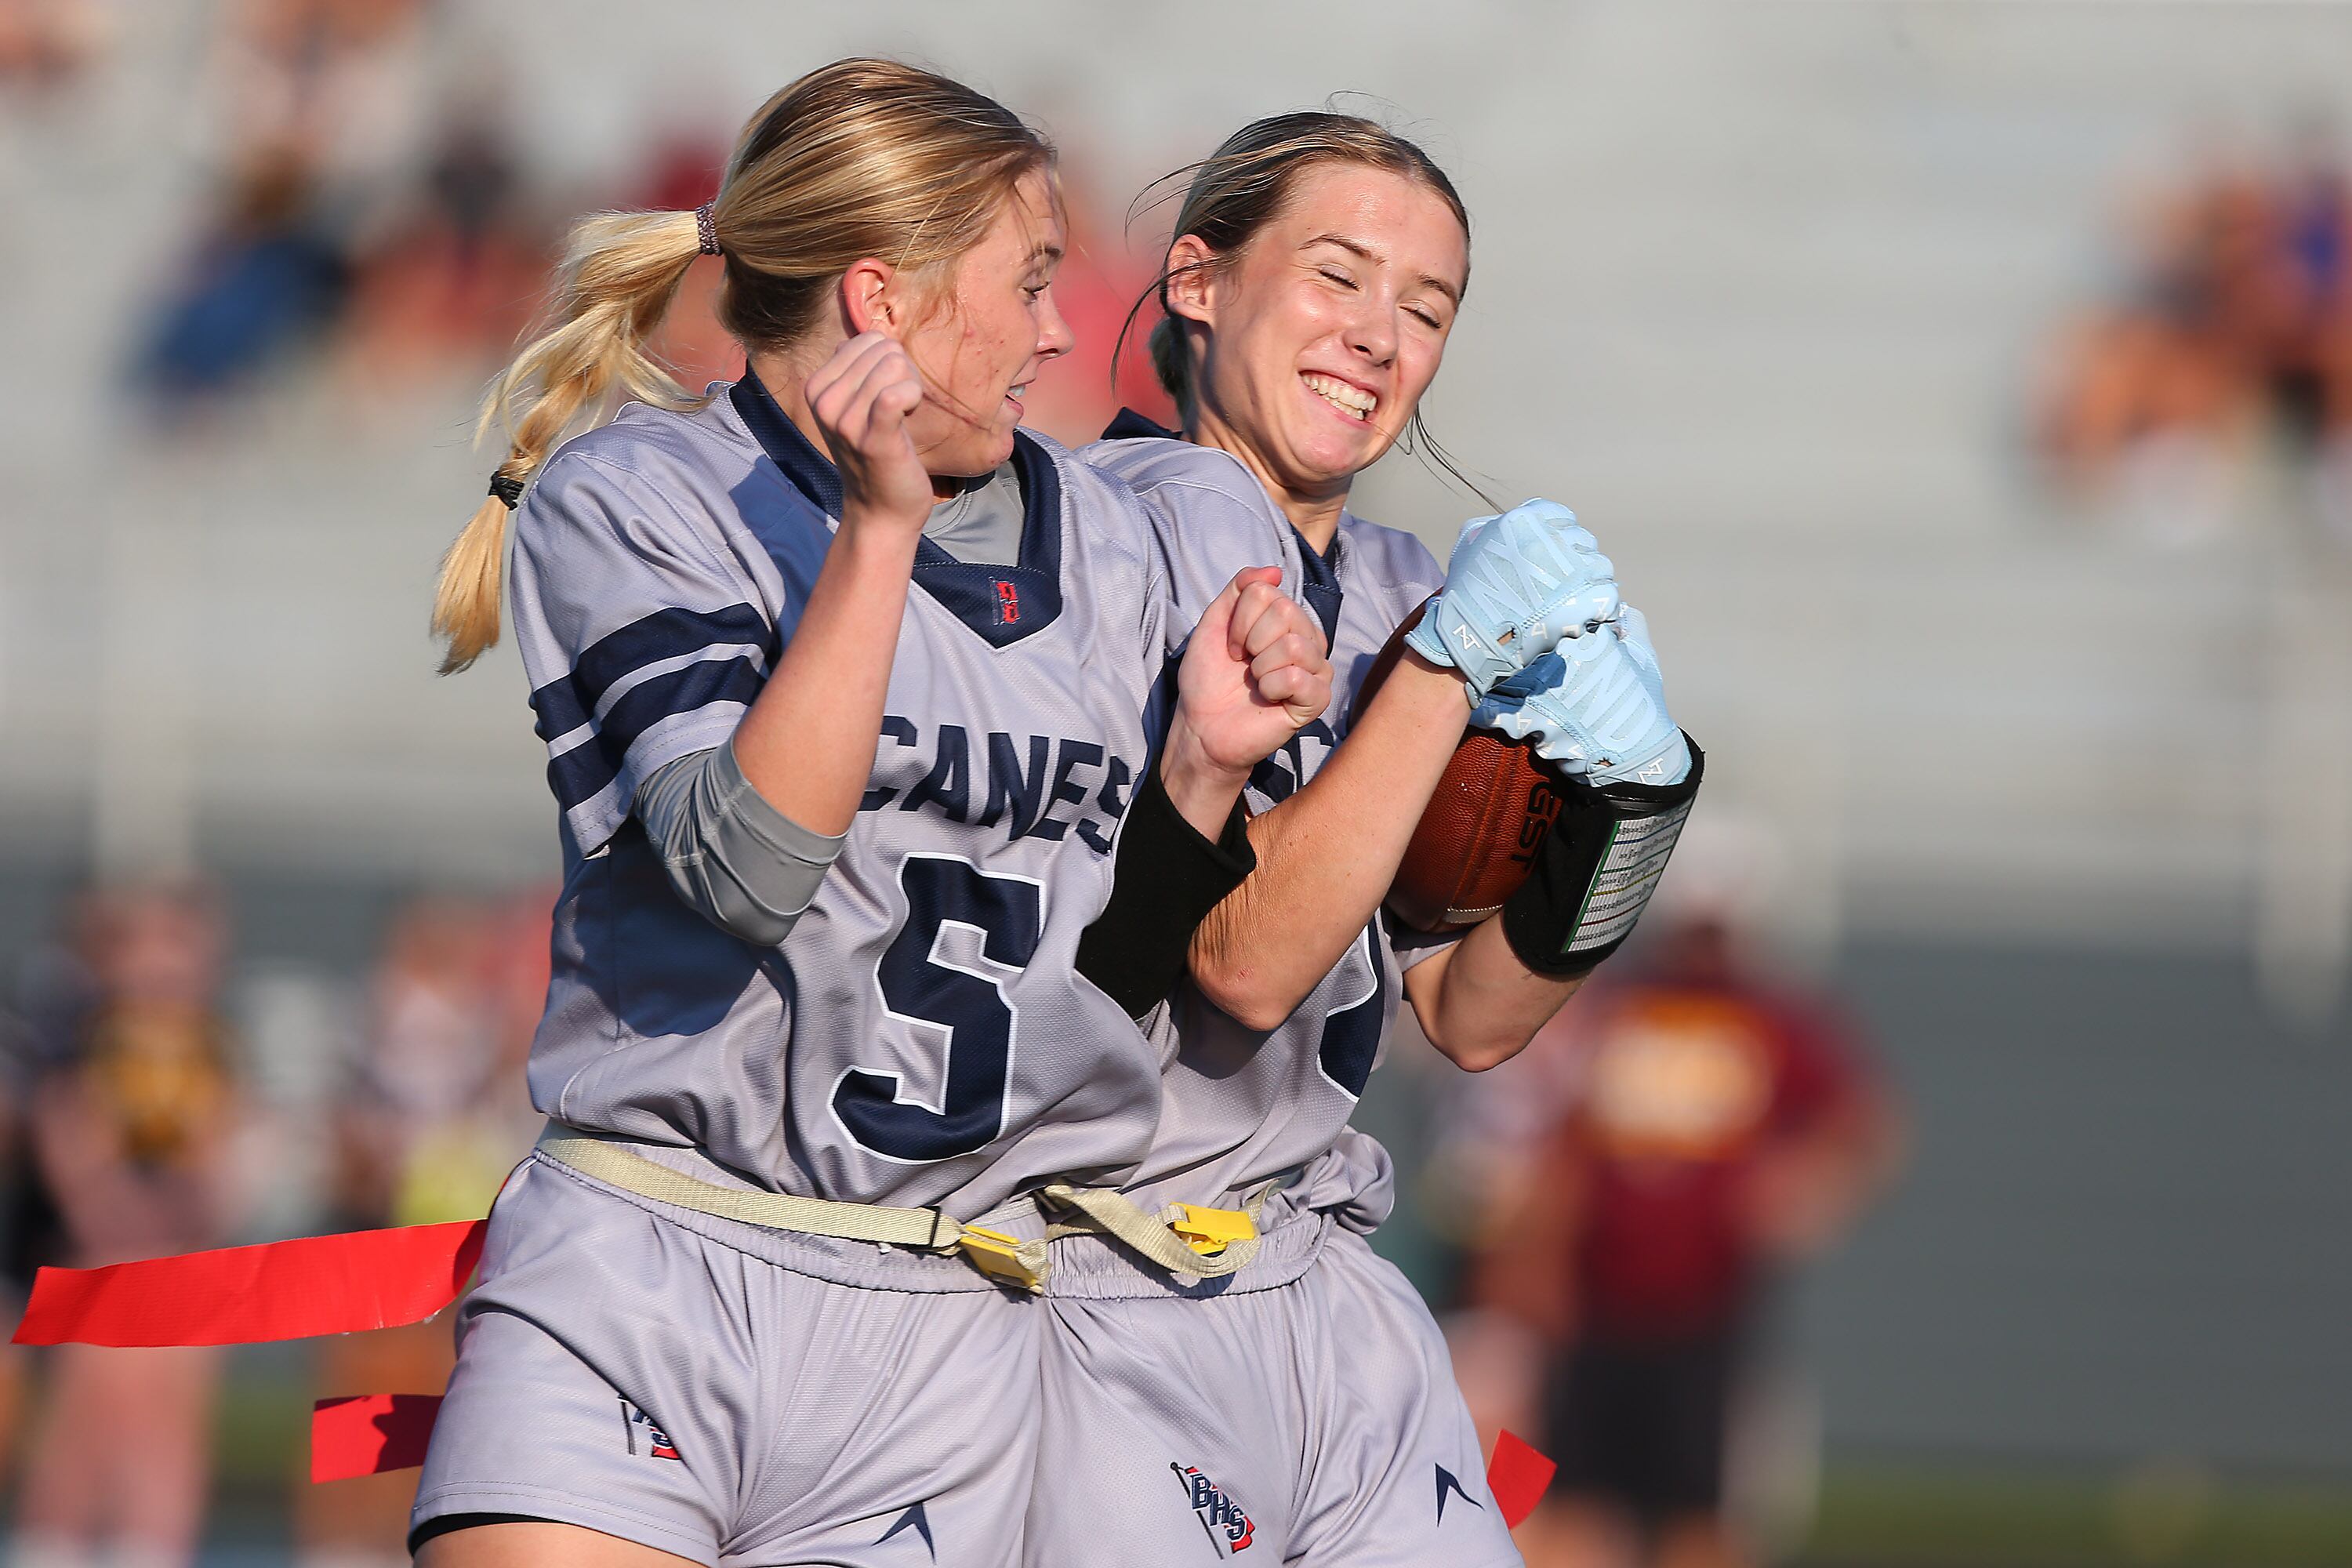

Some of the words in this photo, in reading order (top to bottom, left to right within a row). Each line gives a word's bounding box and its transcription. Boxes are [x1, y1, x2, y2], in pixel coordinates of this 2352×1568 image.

[1512, 781, 1556, 873] GST
[829, 851, 1047, 1164] 5
[1189, 1472, 1249, 1543] BHS
